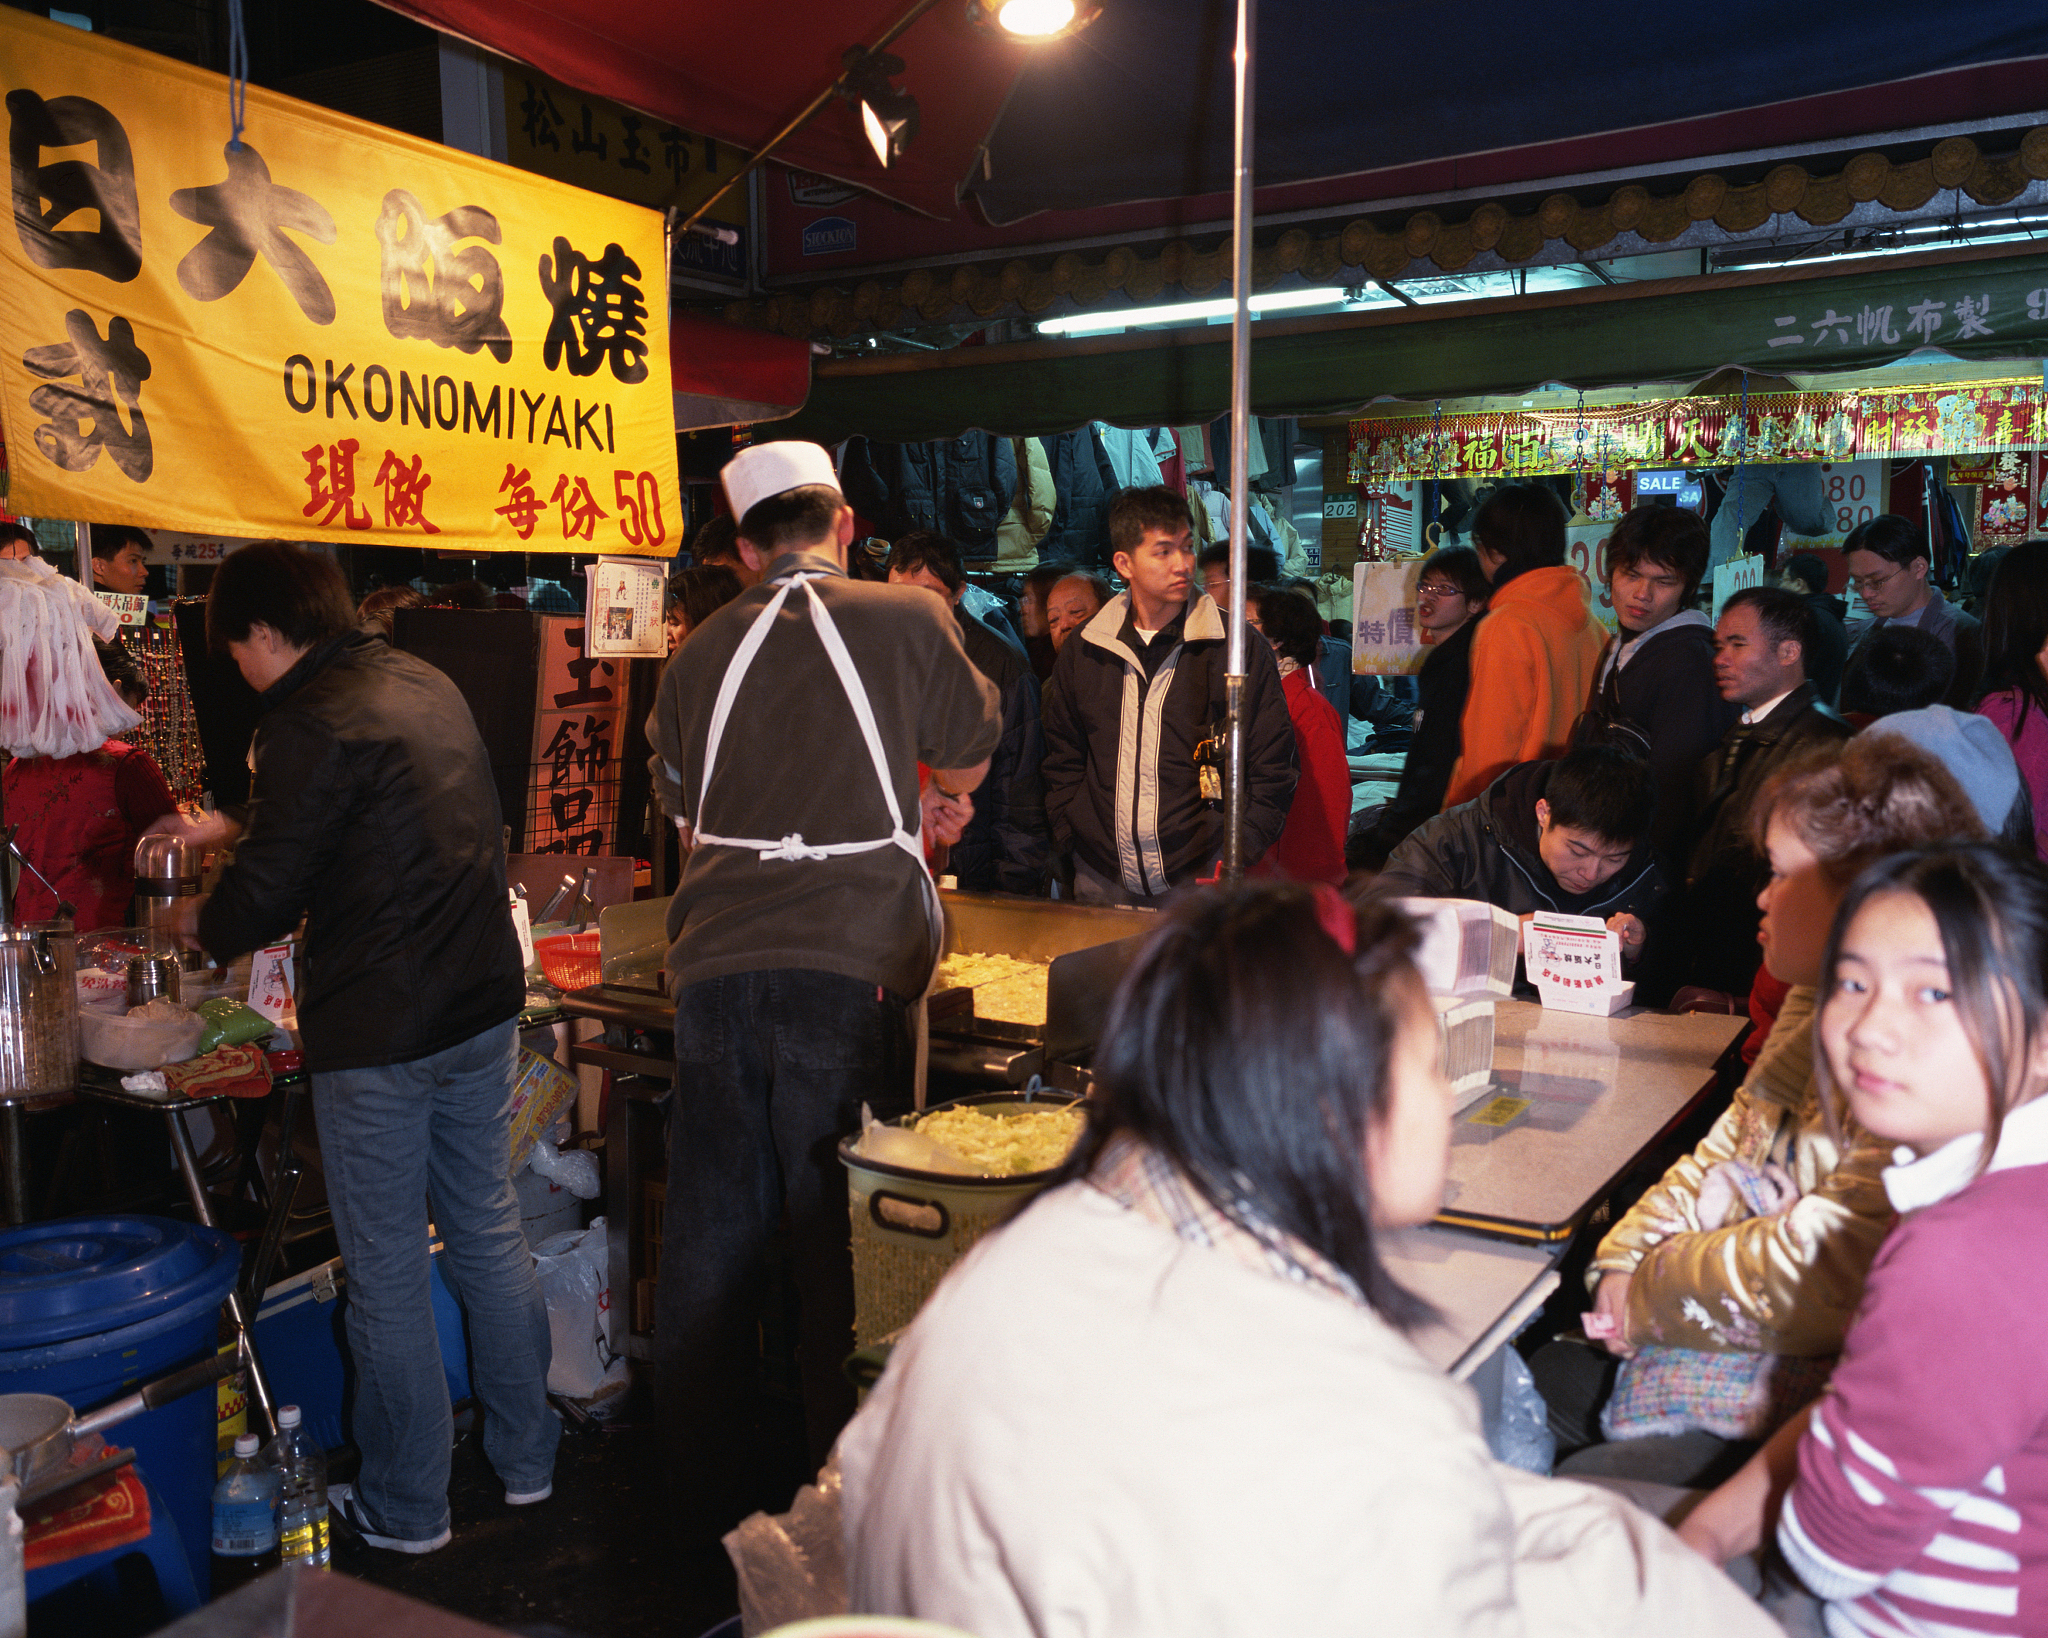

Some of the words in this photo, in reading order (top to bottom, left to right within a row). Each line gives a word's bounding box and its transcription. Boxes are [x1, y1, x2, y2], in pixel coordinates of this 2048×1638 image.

[805, 228, 854, 248] STOCKTON
[1767, 294, 1994, 348] 二六帆布製
[283, 353, 616, 455] OKONOMIYAKI
[300, 437, 441, 535] 現做
[1639, 477, 1682, 490] SALE
[1821, 474, 1866, 502] 80
[1325, 503, 1355, 516] 202
[1359, 607, 1415, 645] 特價
